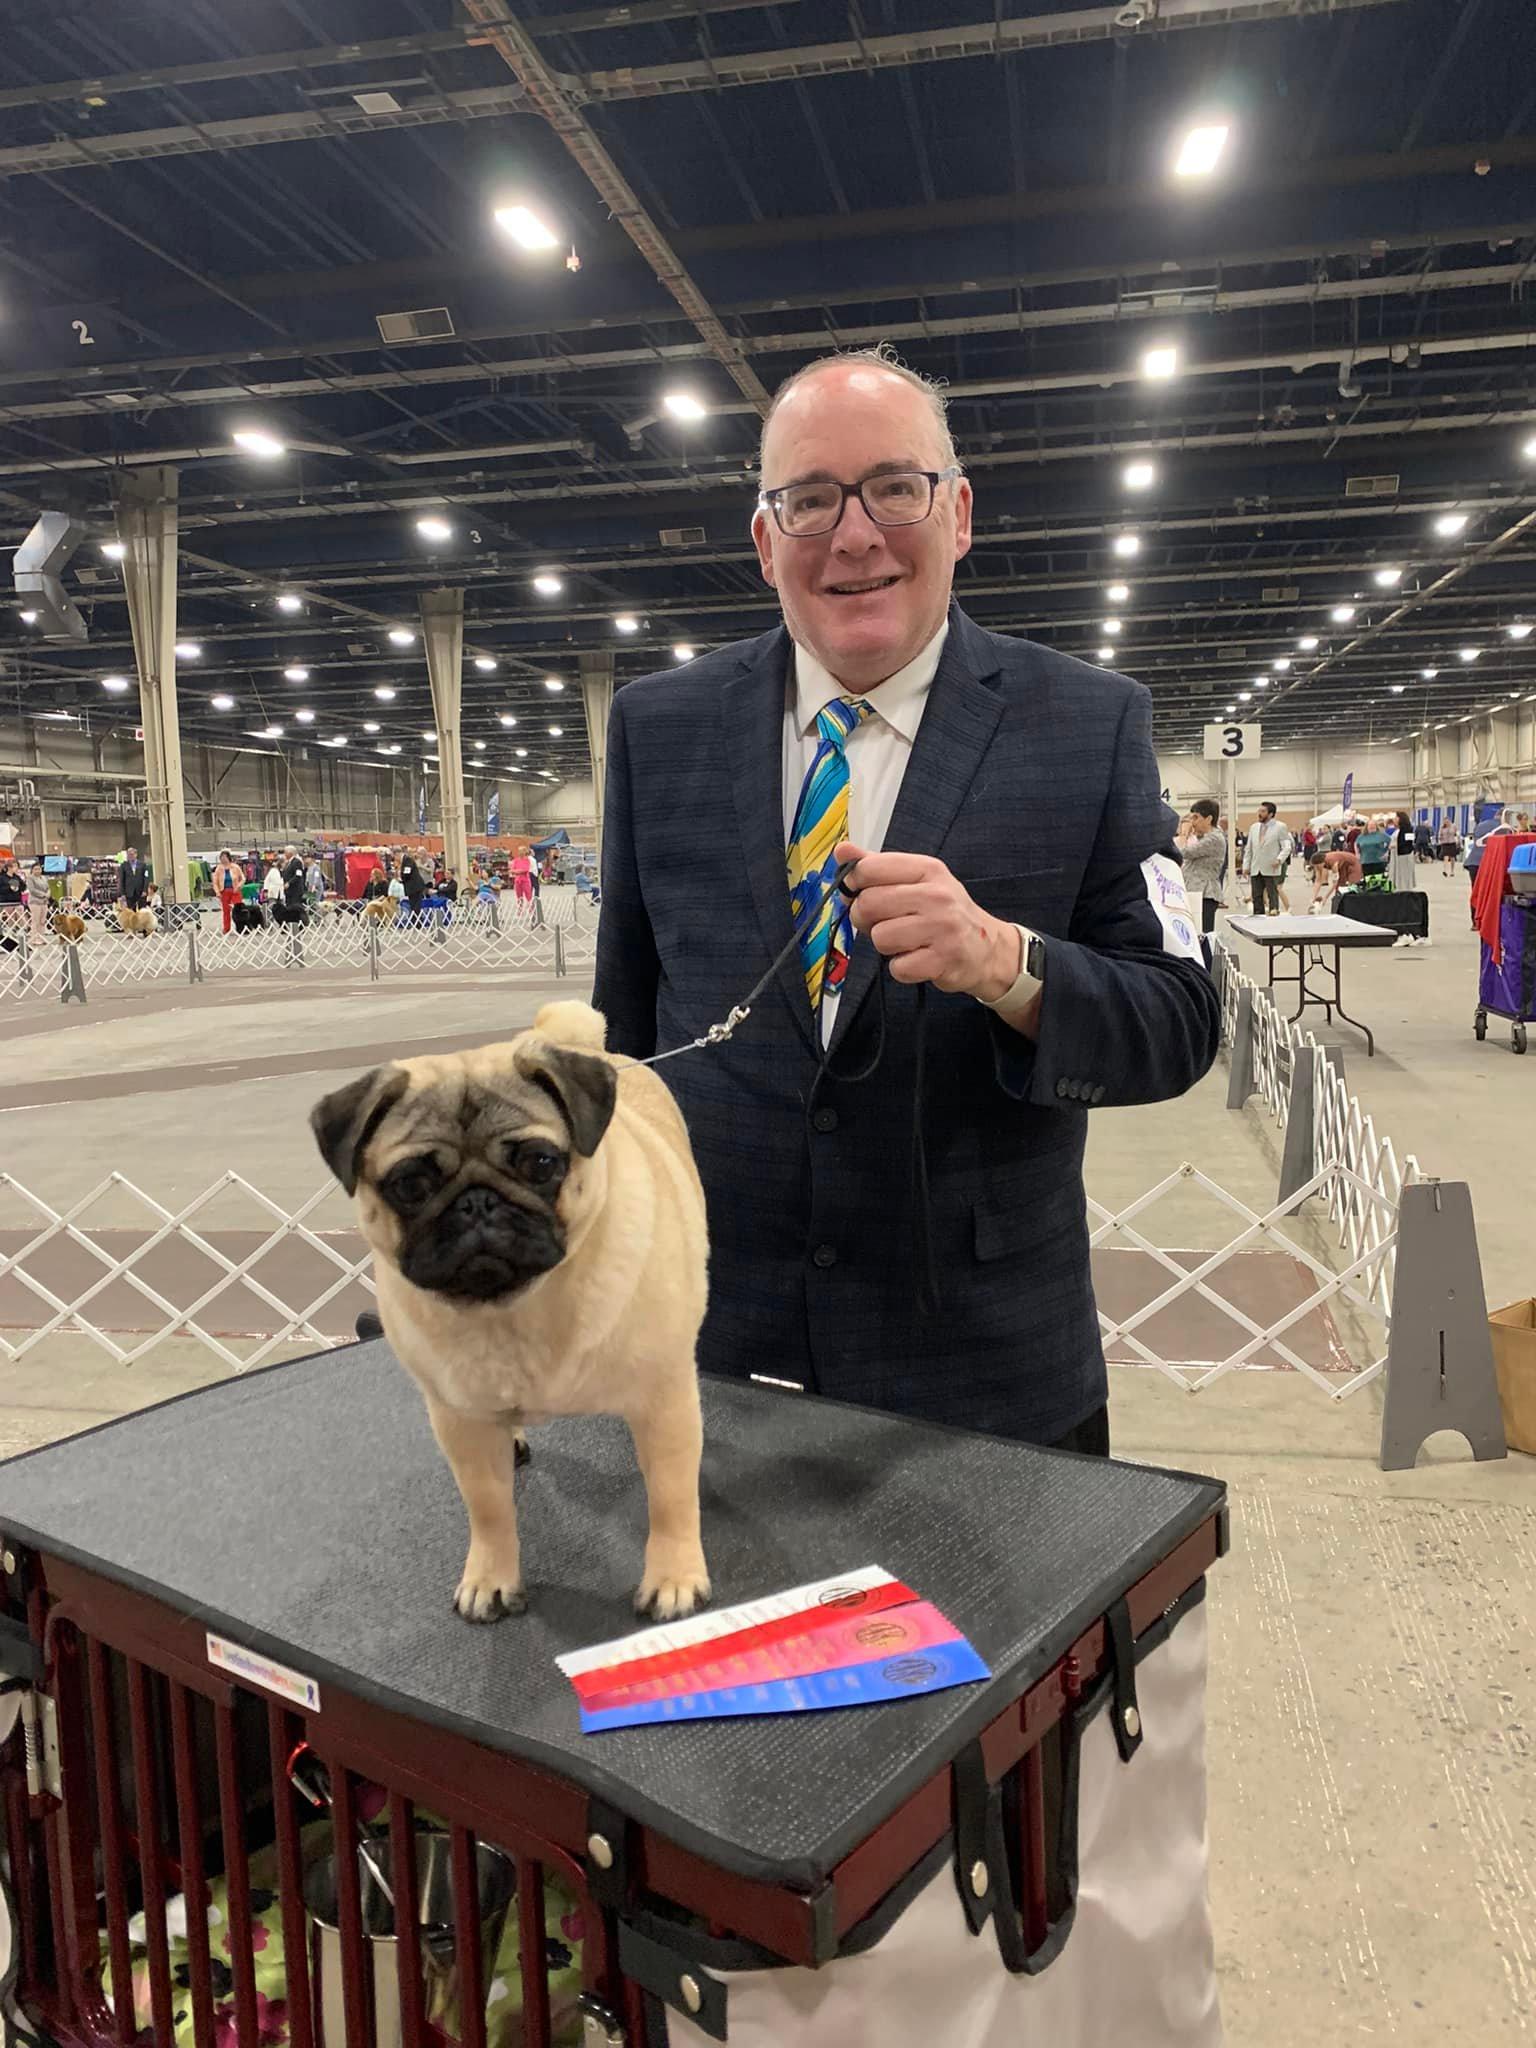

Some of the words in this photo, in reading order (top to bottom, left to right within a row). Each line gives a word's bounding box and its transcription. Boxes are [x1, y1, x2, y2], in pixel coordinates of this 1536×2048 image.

[72, 320, 95, 344] 2
[470, 530, 482, 544] 3
[1222, 727, 1244, 757] 3
[1161, 788, 1171, 802] 4
